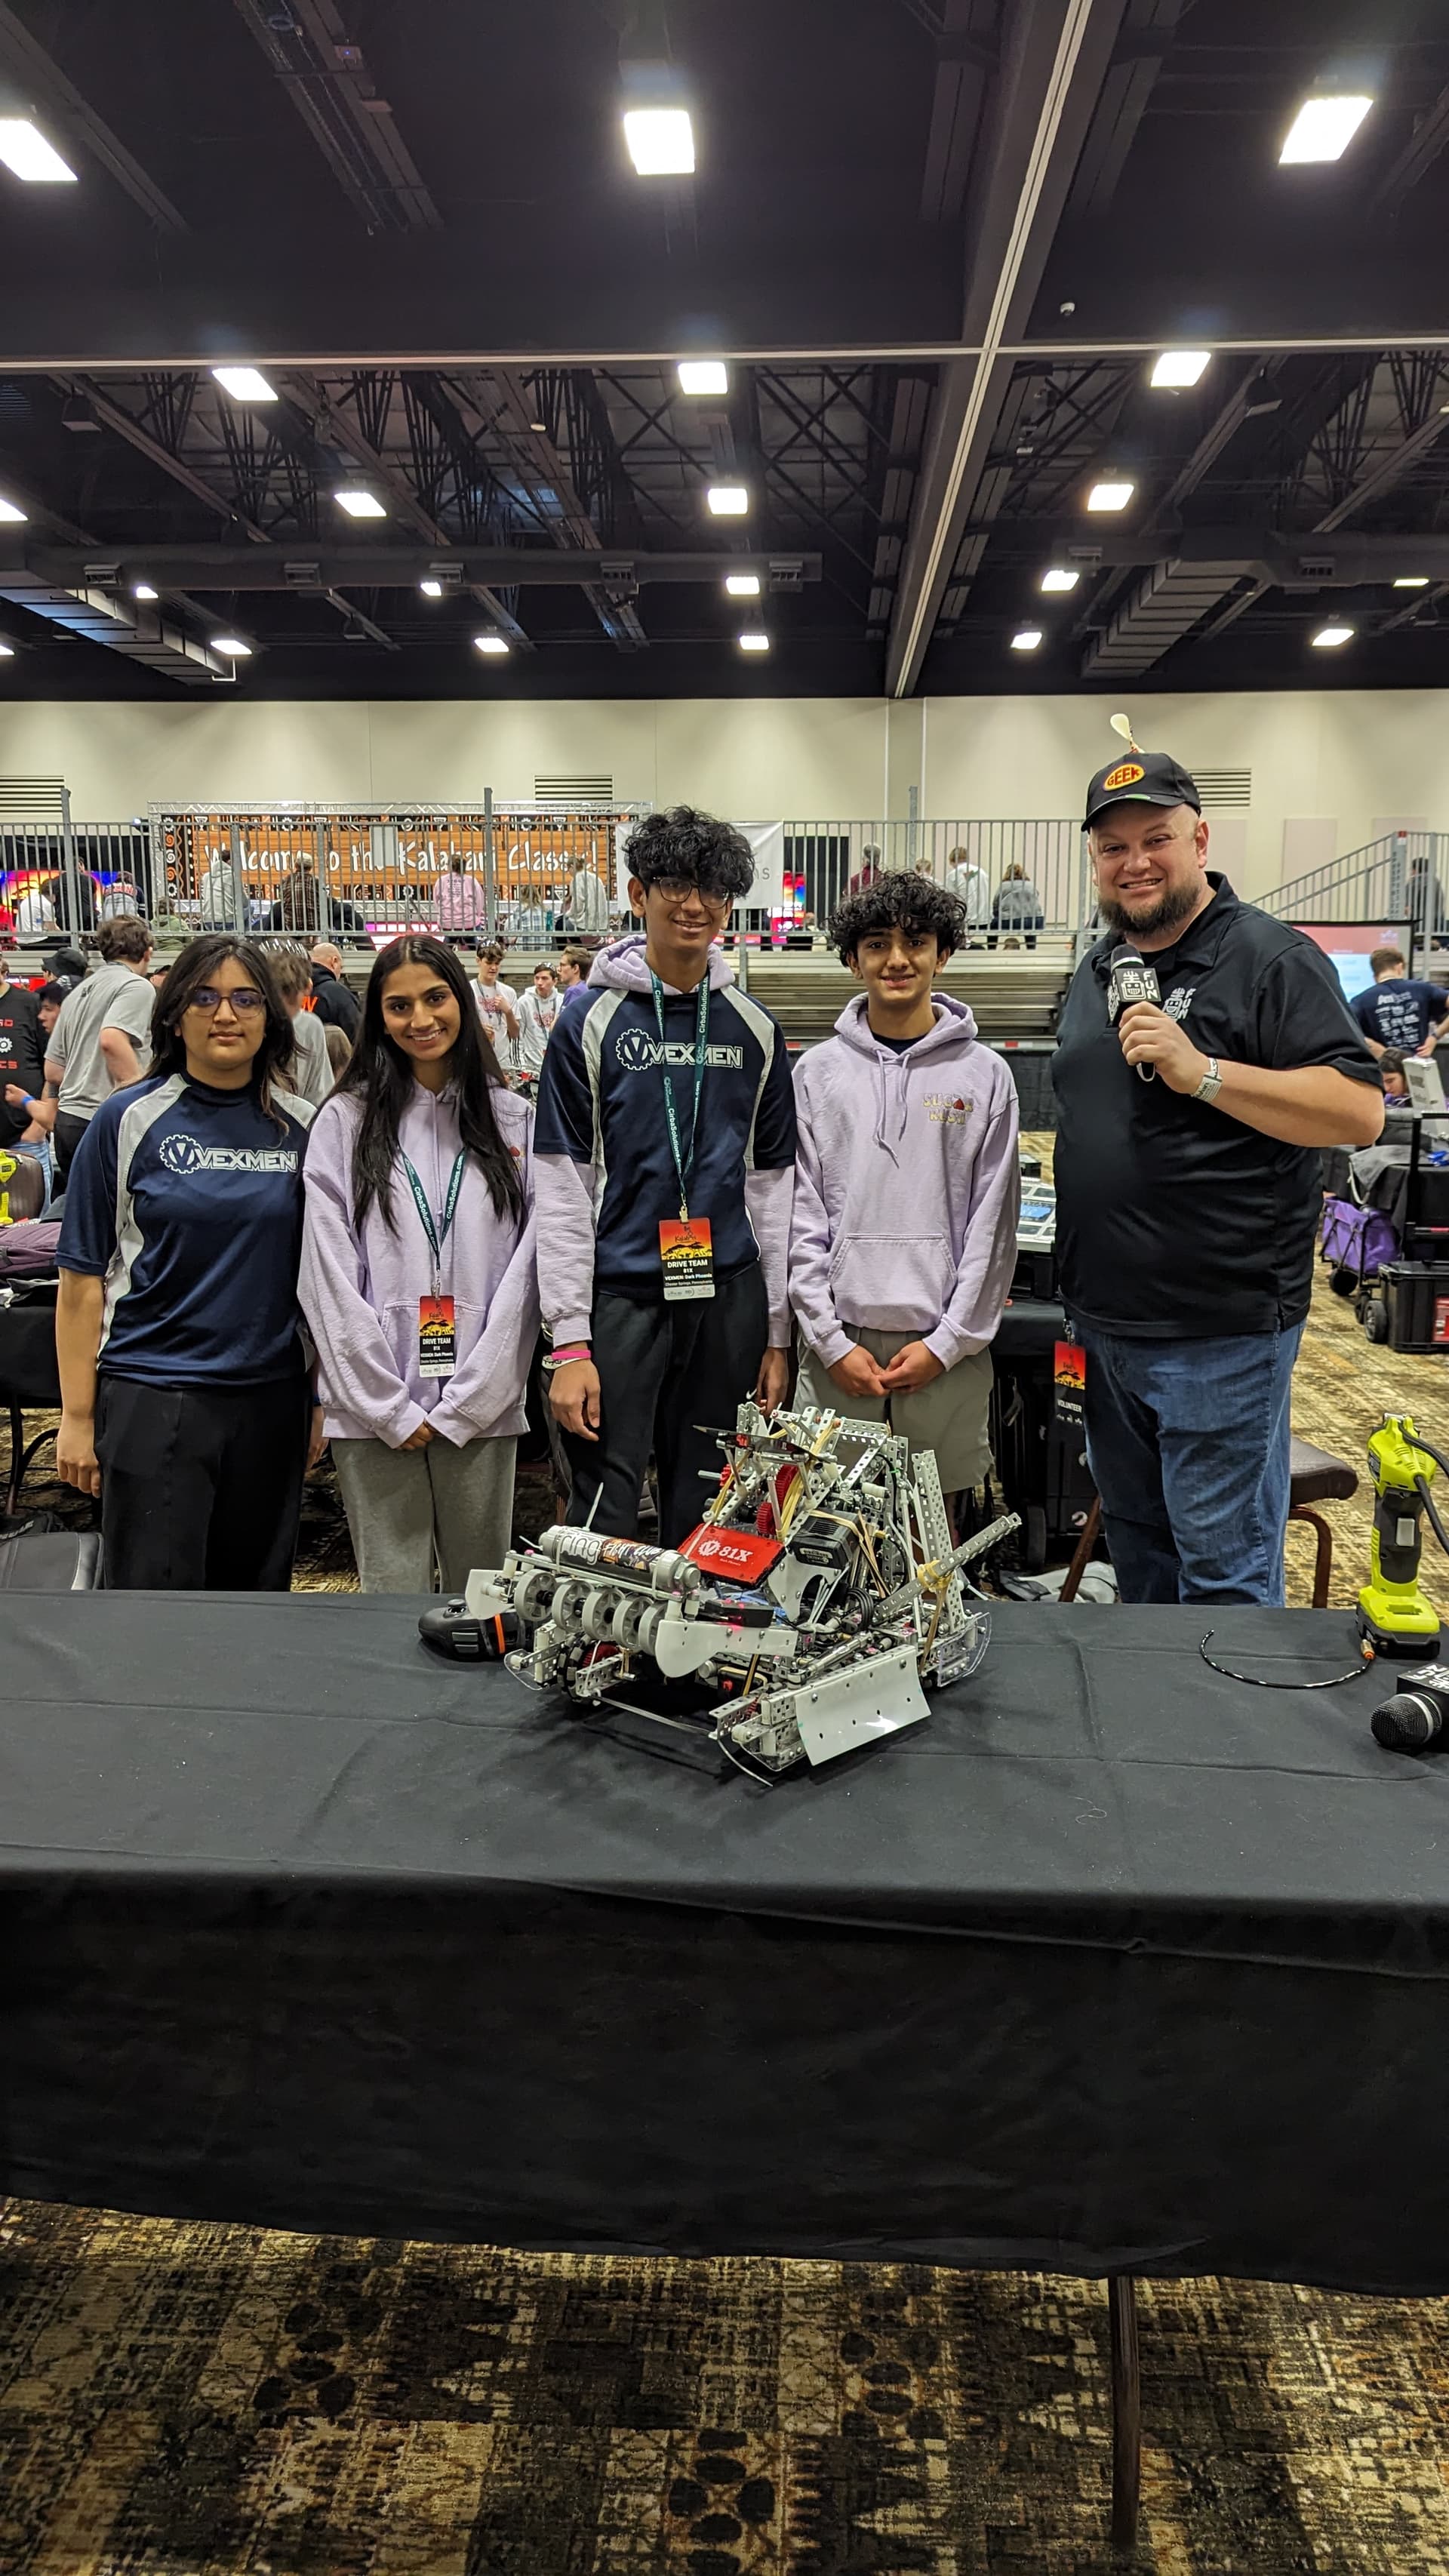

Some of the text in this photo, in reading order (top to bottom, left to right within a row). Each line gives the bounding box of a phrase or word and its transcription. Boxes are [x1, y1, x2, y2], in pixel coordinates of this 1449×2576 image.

[1107, 766, 1140, 786] GEEK
[205, 840, 303, 872] Wlcom
[352, 841, 384, 872] th
[509, 841, 596, 872] Classc!
[194, 1147, 298, 1173] VEXMEN
[1057, 1399, 1082, 1413] VOLUNTEER
[560, 1533, 602, 1565] ring
[718, 1546, 754, 1562] 81X
